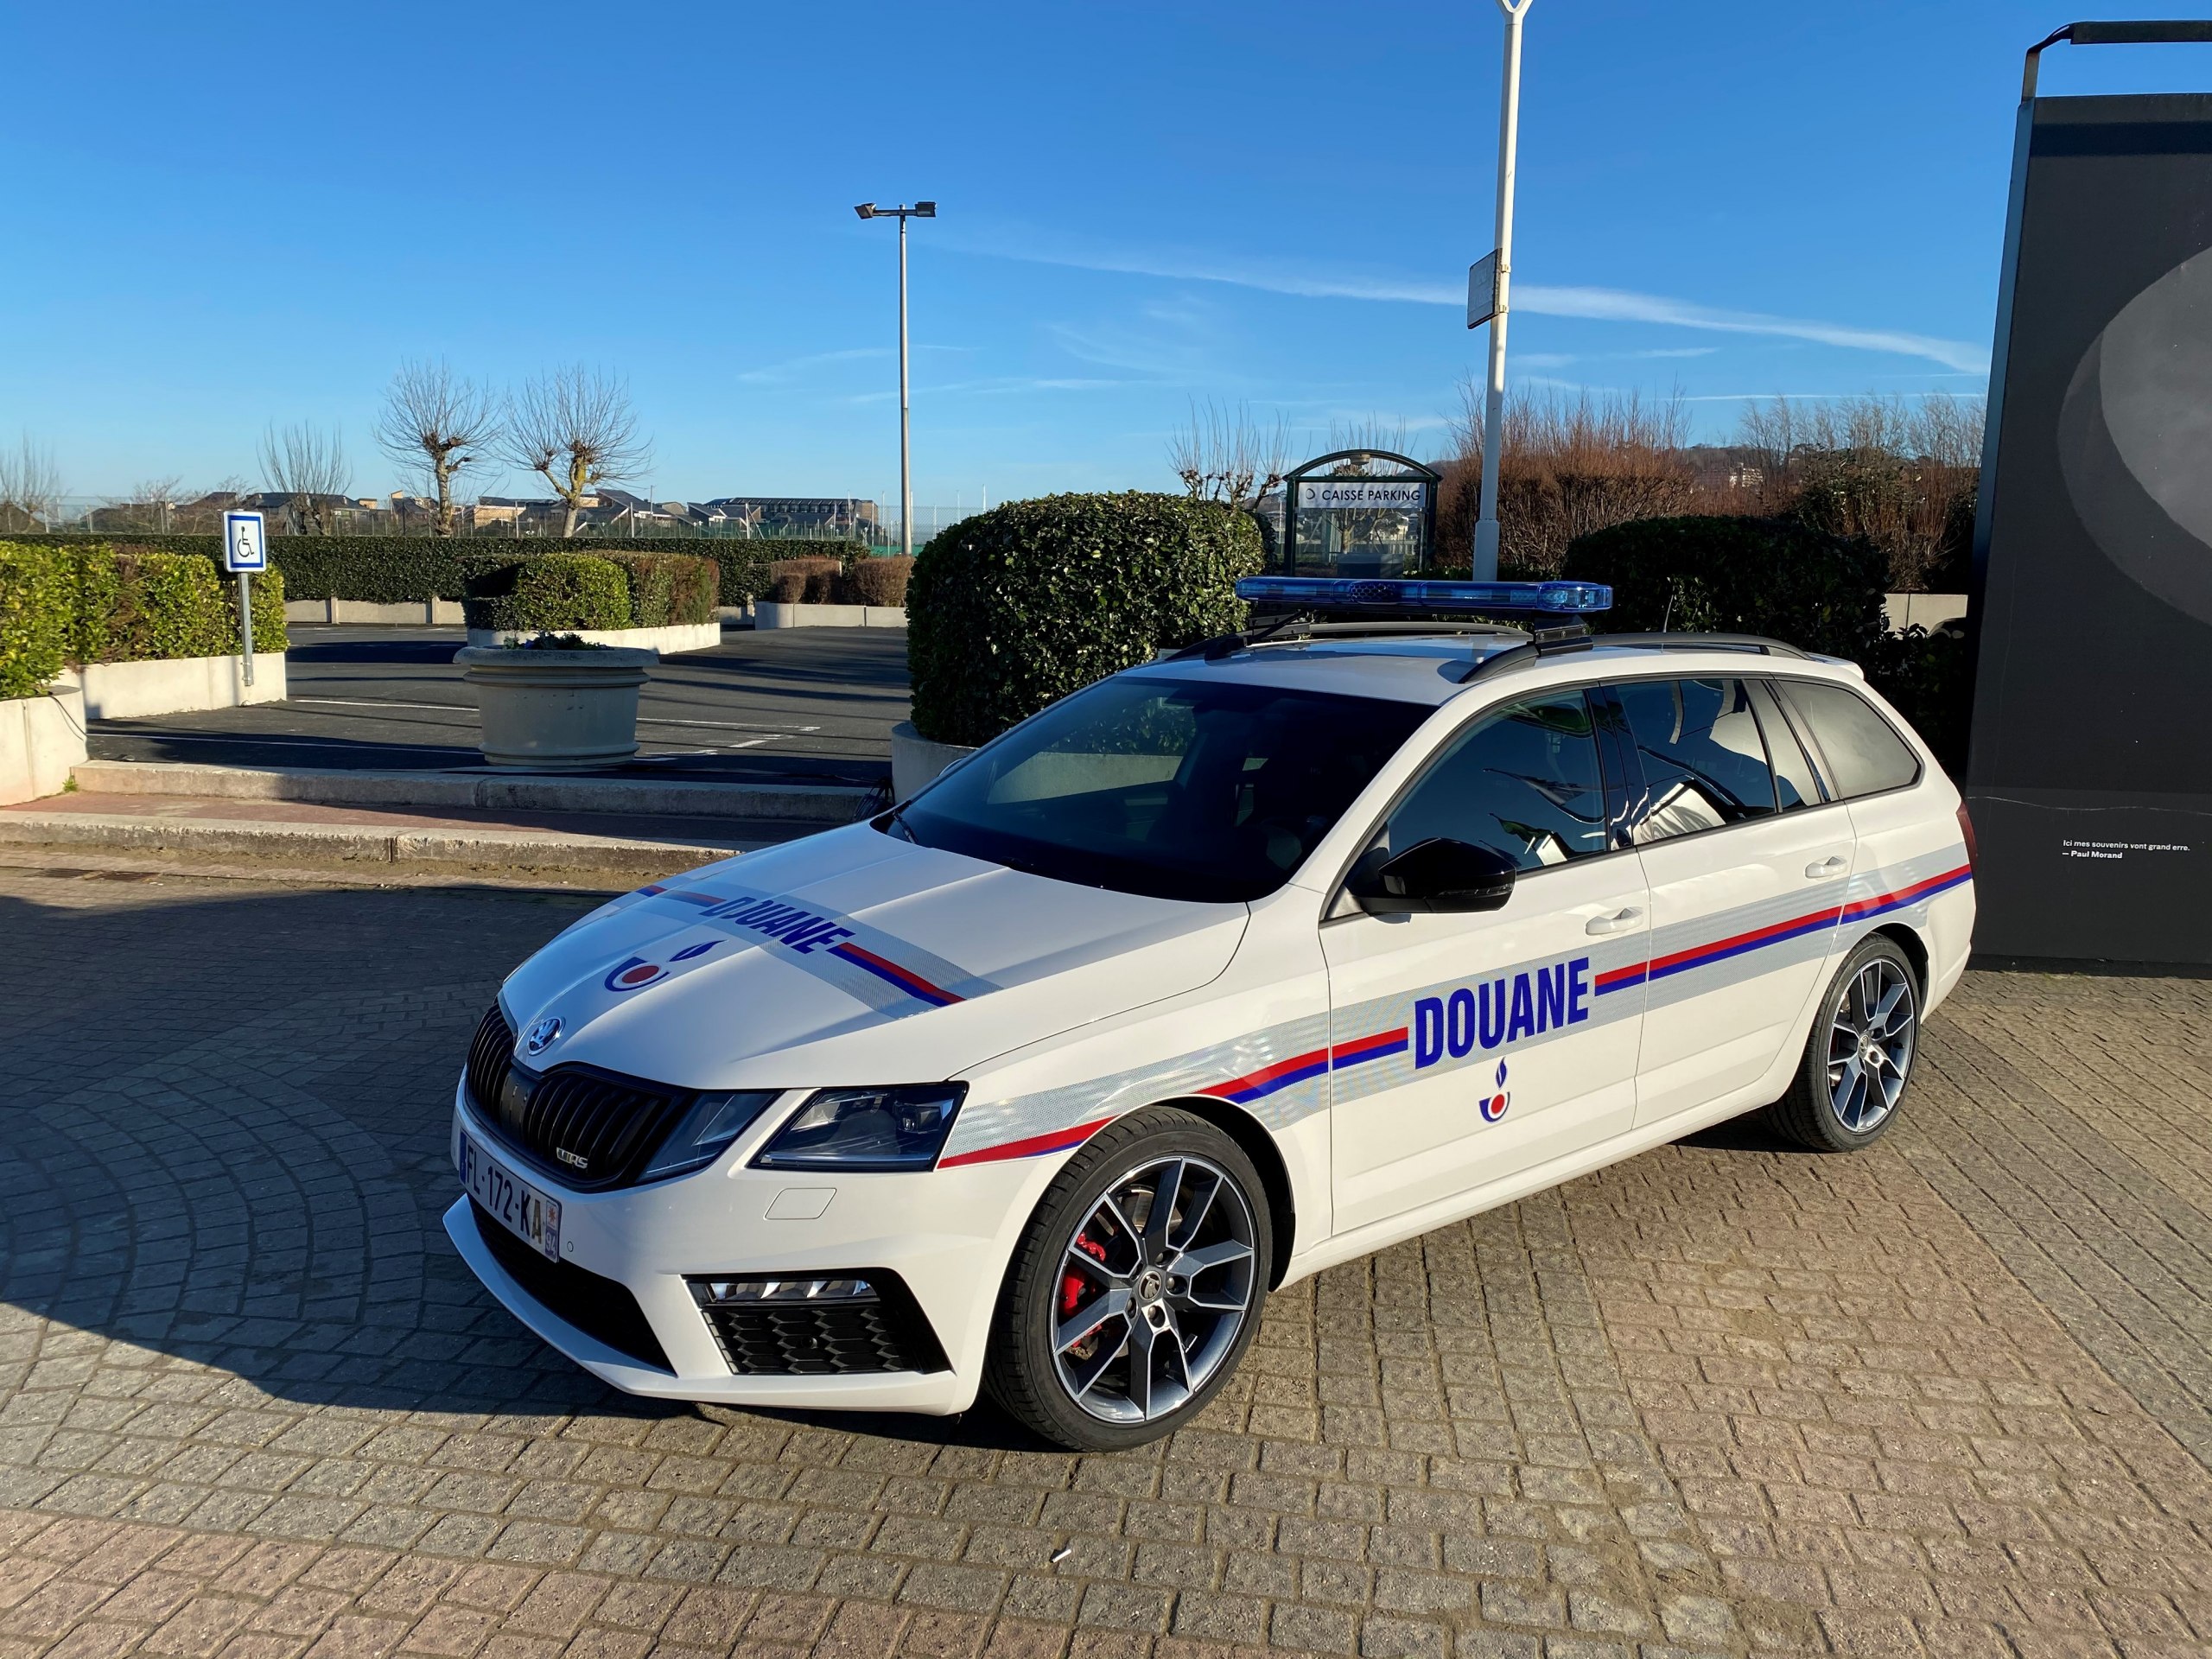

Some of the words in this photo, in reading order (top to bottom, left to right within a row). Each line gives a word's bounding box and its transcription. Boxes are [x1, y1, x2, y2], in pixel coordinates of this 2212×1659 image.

[1322, 490, 1363, 500] CAISSE
[1368, 490, 1421, 500] PARKING
[698, 896, 856, 955] DOUANE
[1414, 957, 1589, 1070] DOUANE
[545, 1231, 556, 1255] 94
